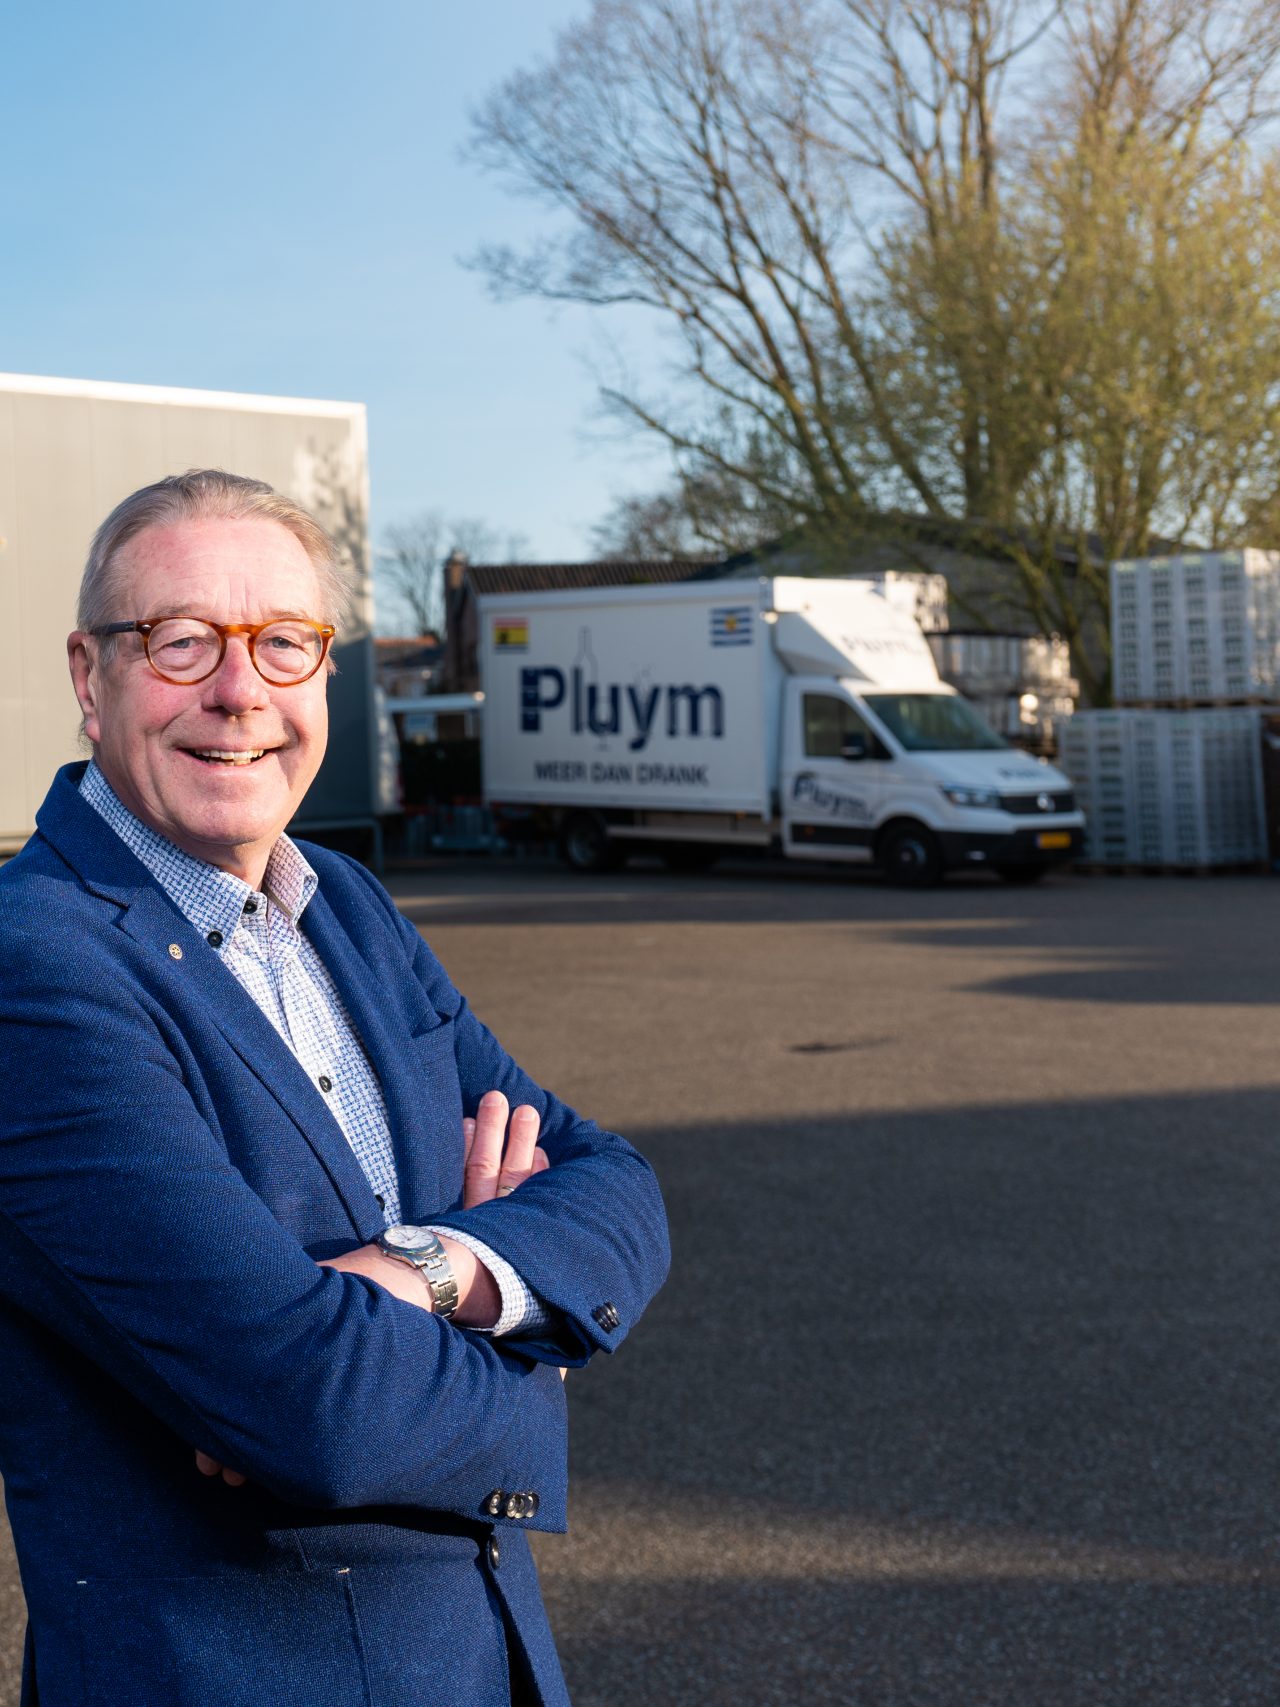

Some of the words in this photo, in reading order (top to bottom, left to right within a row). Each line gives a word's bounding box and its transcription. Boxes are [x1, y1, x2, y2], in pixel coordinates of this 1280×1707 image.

[519, 664, 725, 751] Pluym
[534, 759, 588, 783] MEER
[590, 760, 633, 785] DAN
[636, 761, 710, 787] DRANK
